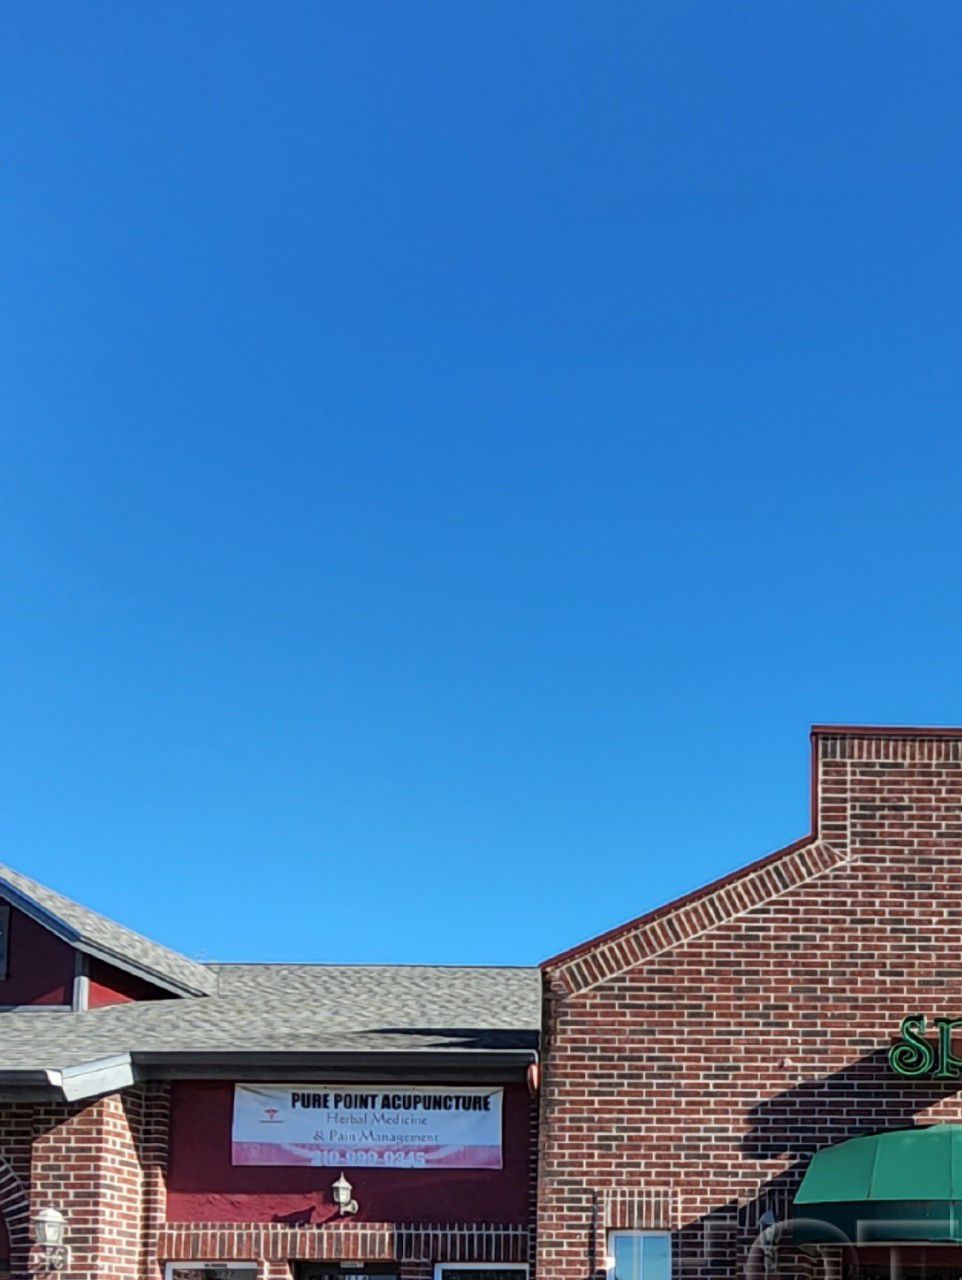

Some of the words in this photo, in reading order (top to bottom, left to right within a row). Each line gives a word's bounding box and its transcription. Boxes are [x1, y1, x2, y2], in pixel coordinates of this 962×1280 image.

[291, 1092, 330, 1109] PURE
[333, 1093, 378, 1110] POINT
[381, 1094, 491, 1112] ACUPUNCTURE
[326, 1112, 367, 1125] Herbal
[371, 1112, 428, 1126] Medicine
[313, 1131, 324, 1142] &
[329, 1130, 356, 1142] Pain
[358, 1131, 440, 1146] Management
